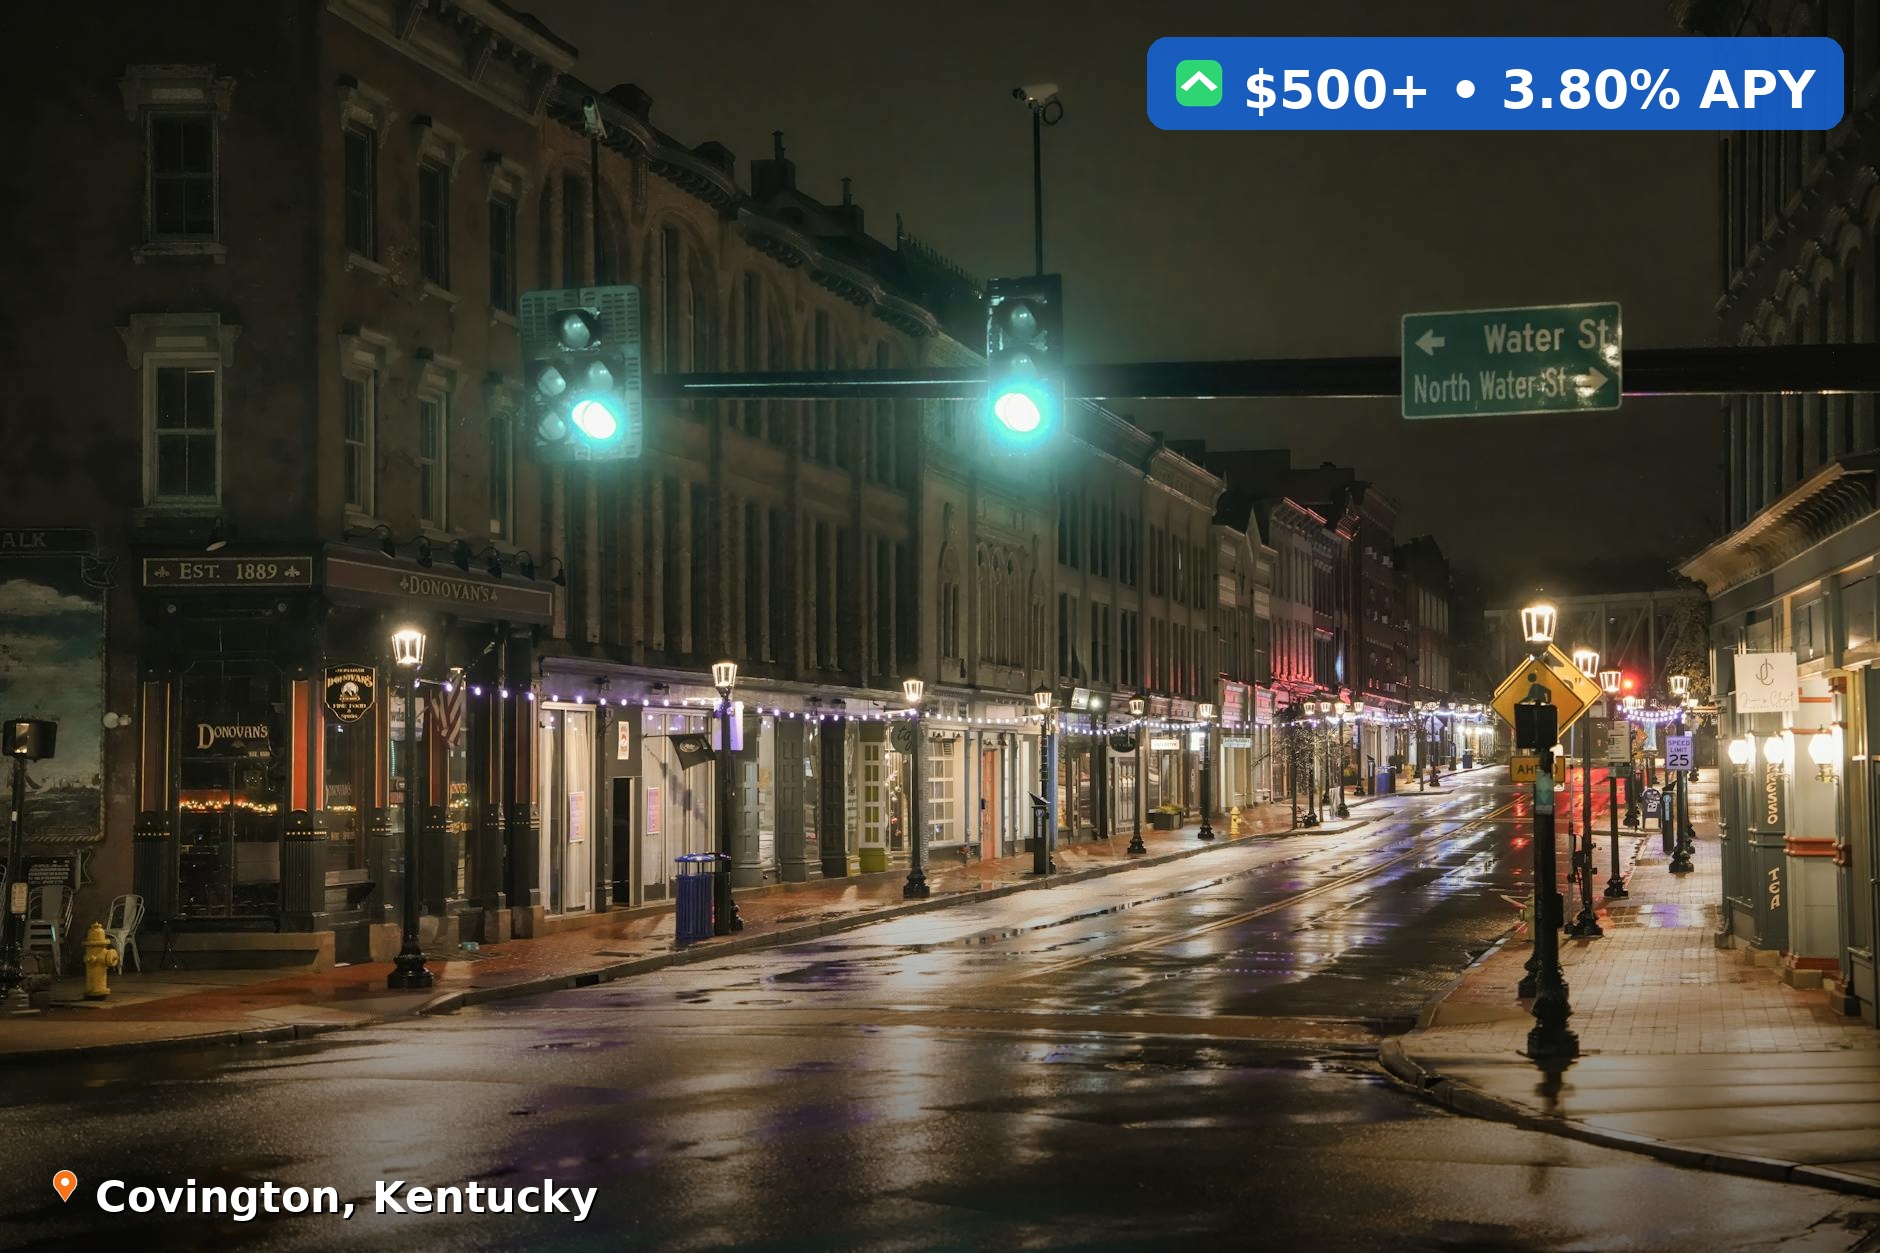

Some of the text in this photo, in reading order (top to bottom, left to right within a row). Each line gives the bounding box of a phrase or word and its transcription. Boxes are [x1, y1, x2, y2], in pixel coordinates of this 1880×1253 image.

[1484, 318, 1610, 354] Water St
[1414, 366, 1567, 404] North Water St
[179, 563, 278, 580] EST. 1889
[409, 575, 490, 602] DONOVAN'S
[197, 723, 269, 750] DONOVAN'S
[1669, 754, 1689, 767] 25
[1768, 866, 1781, 911] TEA
